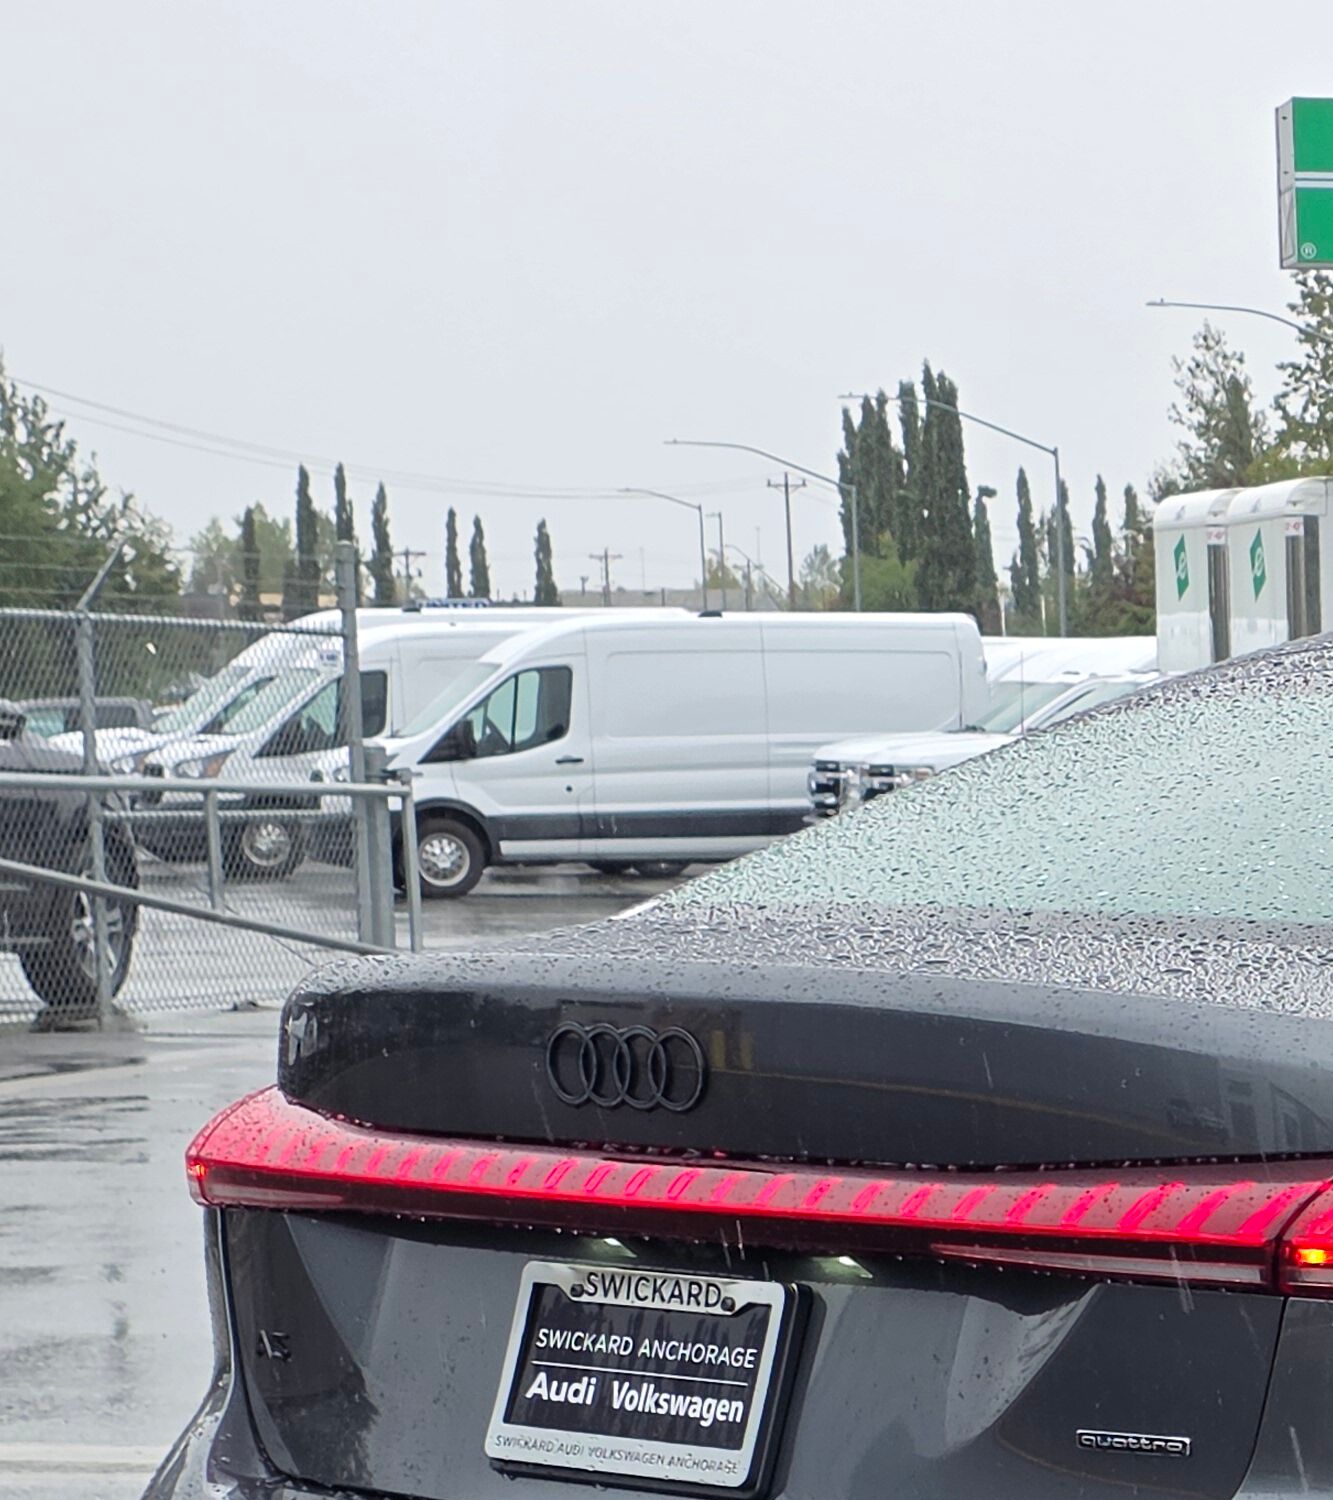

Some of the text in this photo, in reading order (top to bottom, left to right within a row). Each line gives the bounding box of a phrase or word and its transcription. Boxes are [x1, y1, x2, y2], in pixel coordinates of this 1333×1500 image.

[583, 1272, 722, 1308] SWICKARD
[535, 1328, 758, 1369] SWICKARD ANCHORAGE
[525, 1371, 744, 1427] Audi Volkswagen
[494, 1435, 739, 1475] SWICKARD AUDI VOLKSWAGEN ANCHORAGE
[1080, 1434, 1184, 1452] quattro
